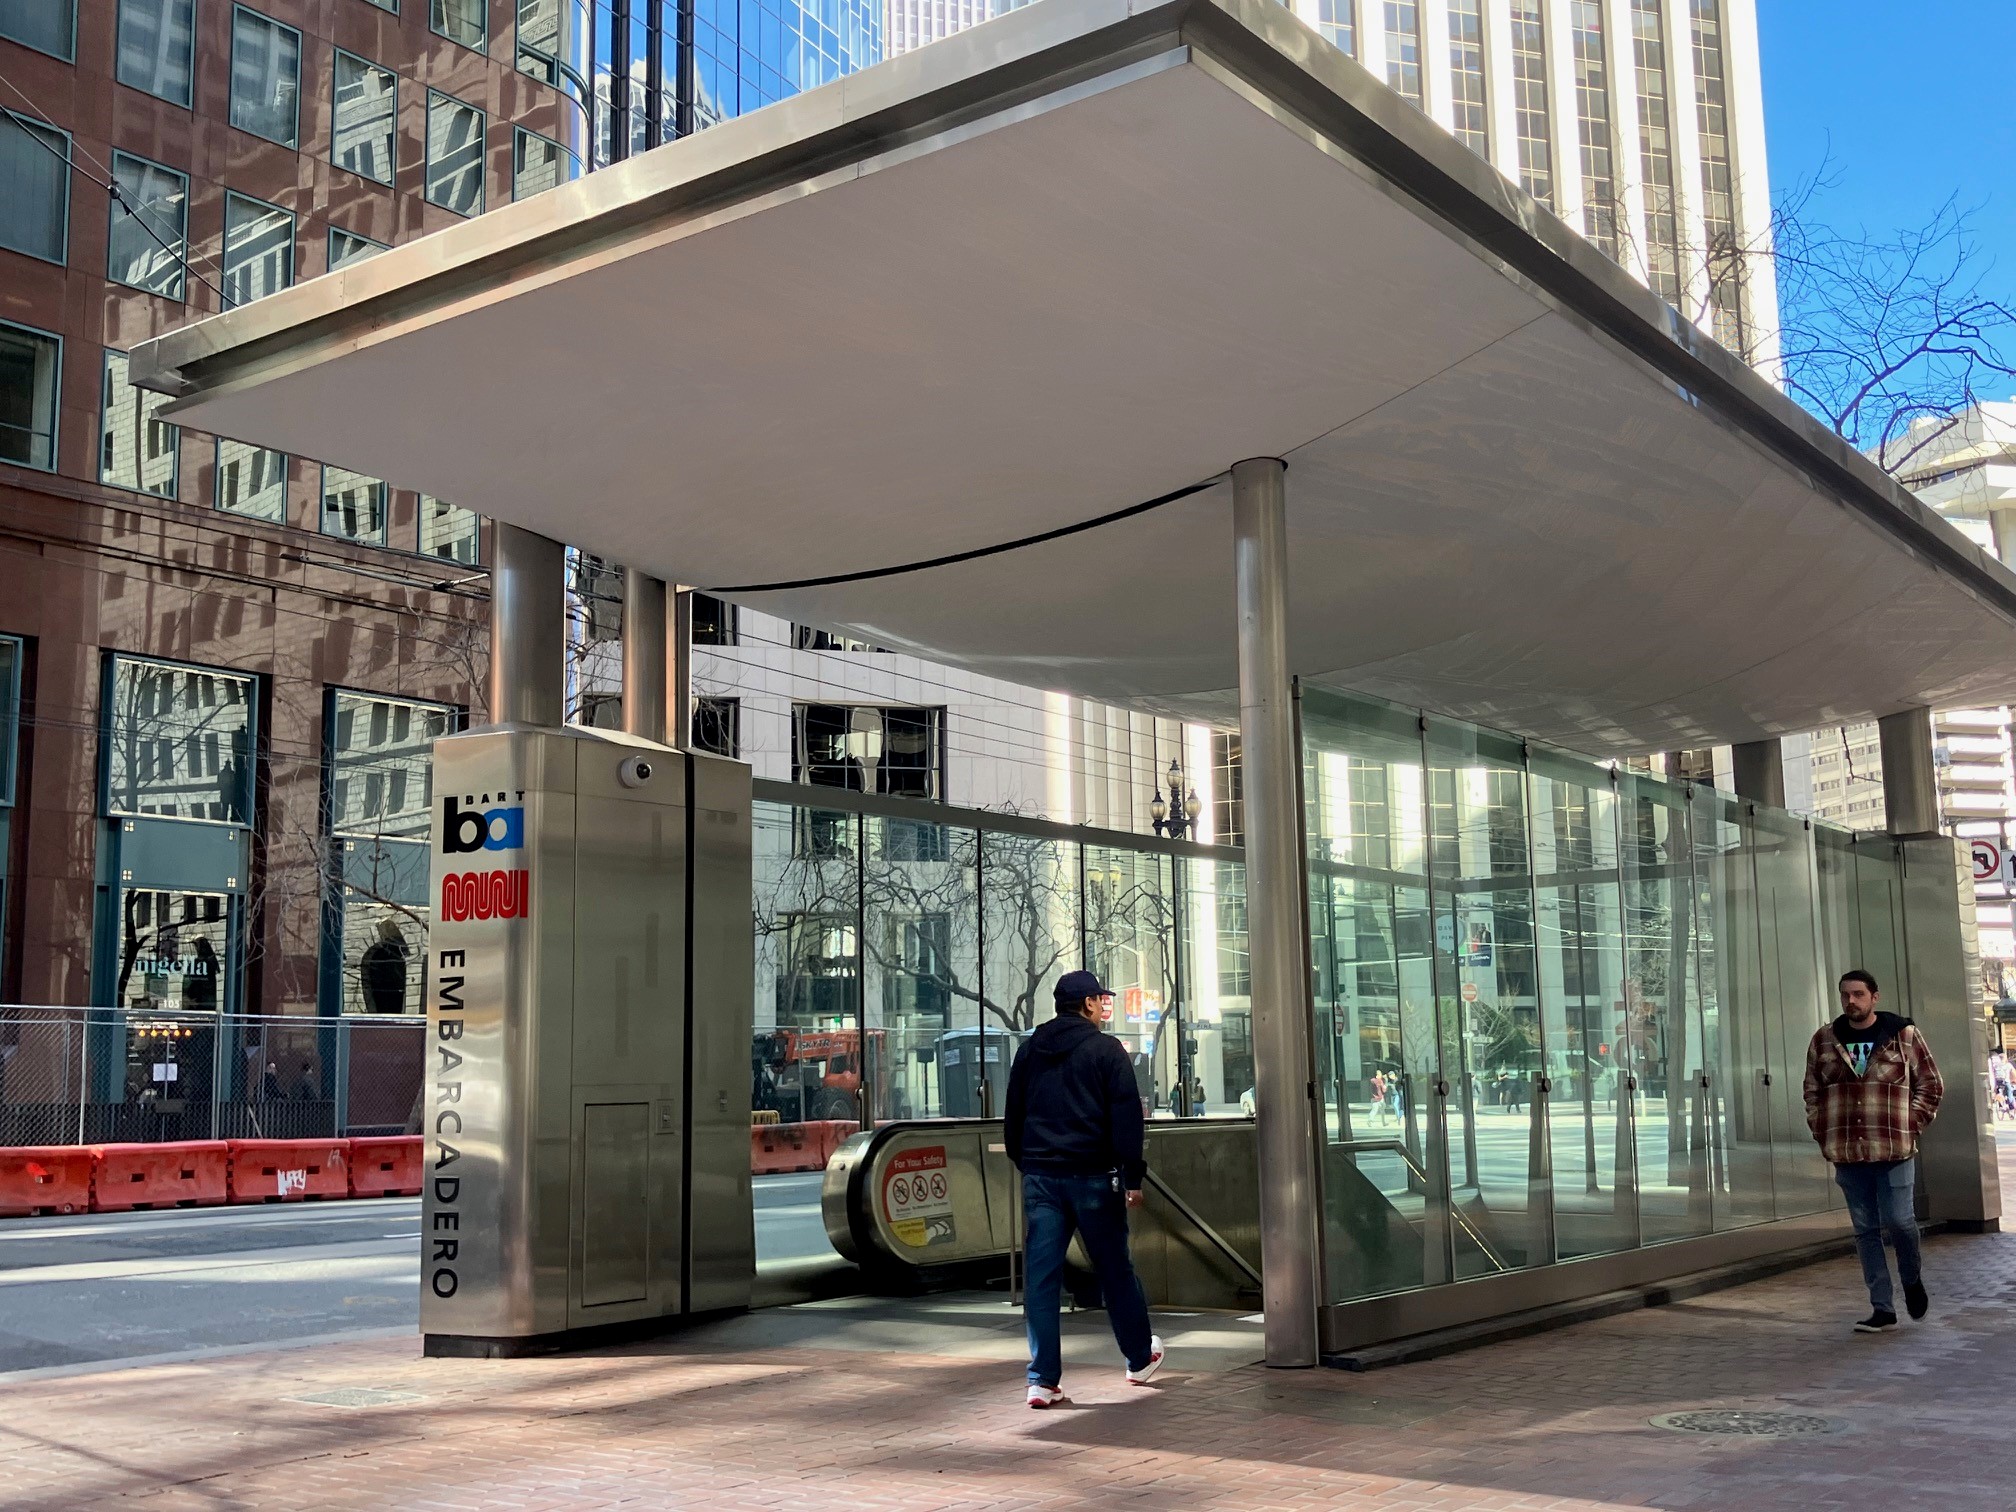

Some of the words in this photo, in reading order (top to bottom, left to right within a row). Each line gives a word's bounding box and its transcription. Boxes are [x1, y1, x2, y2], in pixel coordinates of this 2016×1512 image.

[465, 791, 525, 805] BART
[136, 953, 208, 978] nigella
[163, 999, 180, 1009] 105
[432, 949, 465, 1299] EMBARCADERO
[894, 1159, 906, 1169] For
[907, 1158, 922, 1167] Your
[923, 1155, 943, 1166] Safety
